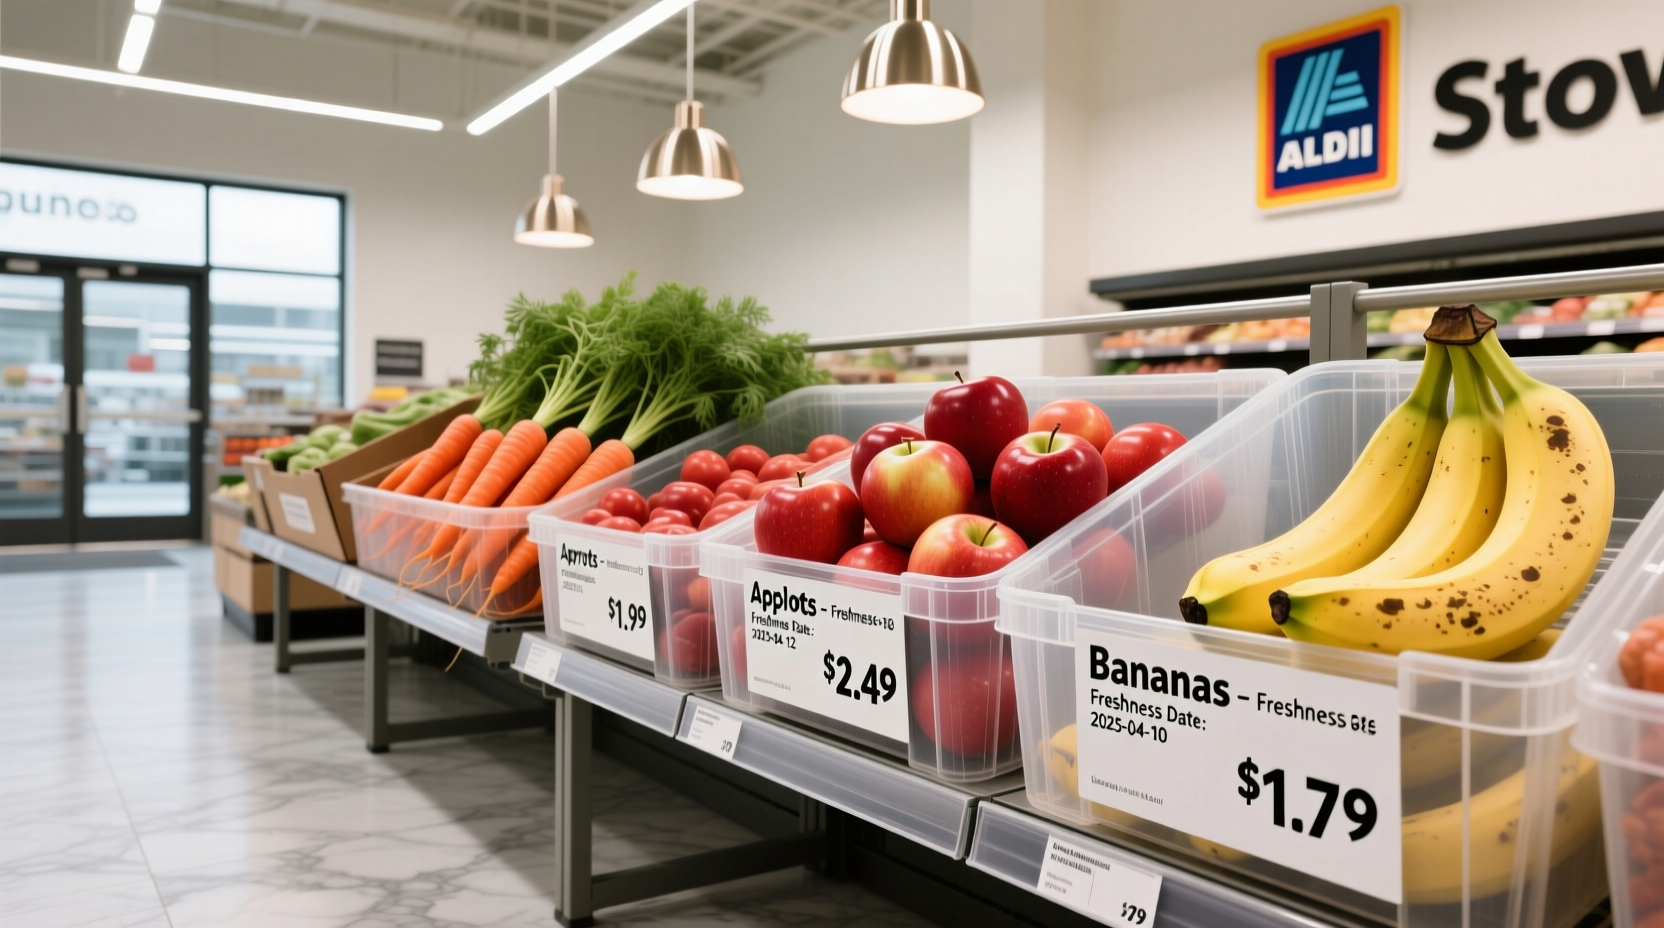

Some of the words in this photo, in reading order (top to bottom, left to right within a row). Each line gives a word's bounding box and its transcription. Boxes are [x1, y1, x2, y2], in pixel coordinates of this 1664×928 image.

[1276, 123, 1374, 173] ALDII
[608, 596, 647, 632] $1.99
[750, 581, 817, 617] Applots
[786, 636, 797, 650] 12
[823, 649, 897, 705] $2.49
[1089, 644, 1231, 708] Bananas
[1257, 692, 1347, 729] Freshness
[1090, 688, 1163, 720] Freshness
[1167, 704, 1207, 731] Date:
[1090, 711, 1168, 743] 2025-04-10
[1237, 756, 1378, 842] $1.79
